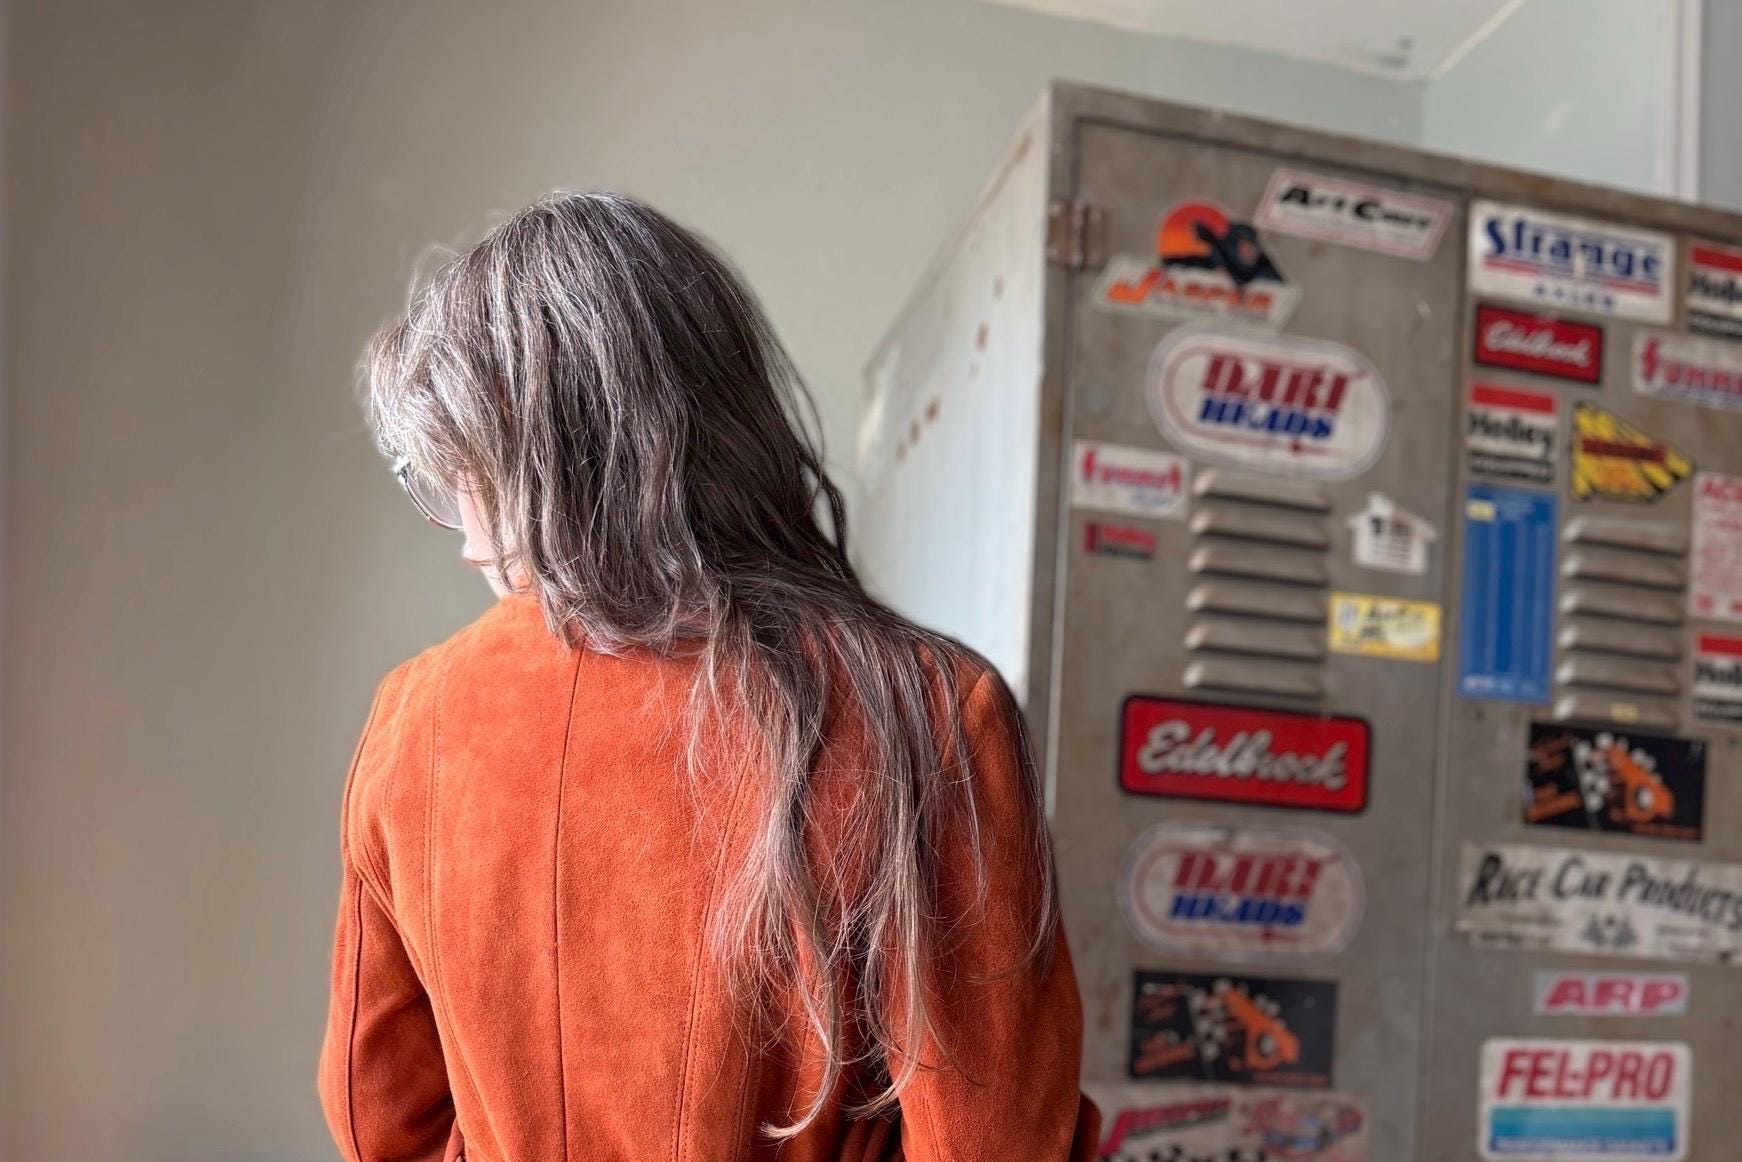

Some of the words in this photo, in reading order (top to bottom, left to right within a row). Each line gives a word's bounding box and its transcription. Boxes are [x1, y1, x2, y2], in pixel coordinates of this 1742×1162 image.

[1485, 216, 1660, 280] Strange
[1482, 320, 1592, 370] Edelbrock
[1202, 353, 1352, 414] DART
[1198, 394, 1336, 441] HEADS
[1469, 413, 1555, 449] Holley
[1136, 719, 1348, 791] Edelbrock
[1172, 851, 1324, 898] DART
[1168, 895, 1306, 927] HEADS
[1545, 975, 1688, 1015] ARP
[1496, 1048, 1676, 1101] FEL-PRO
